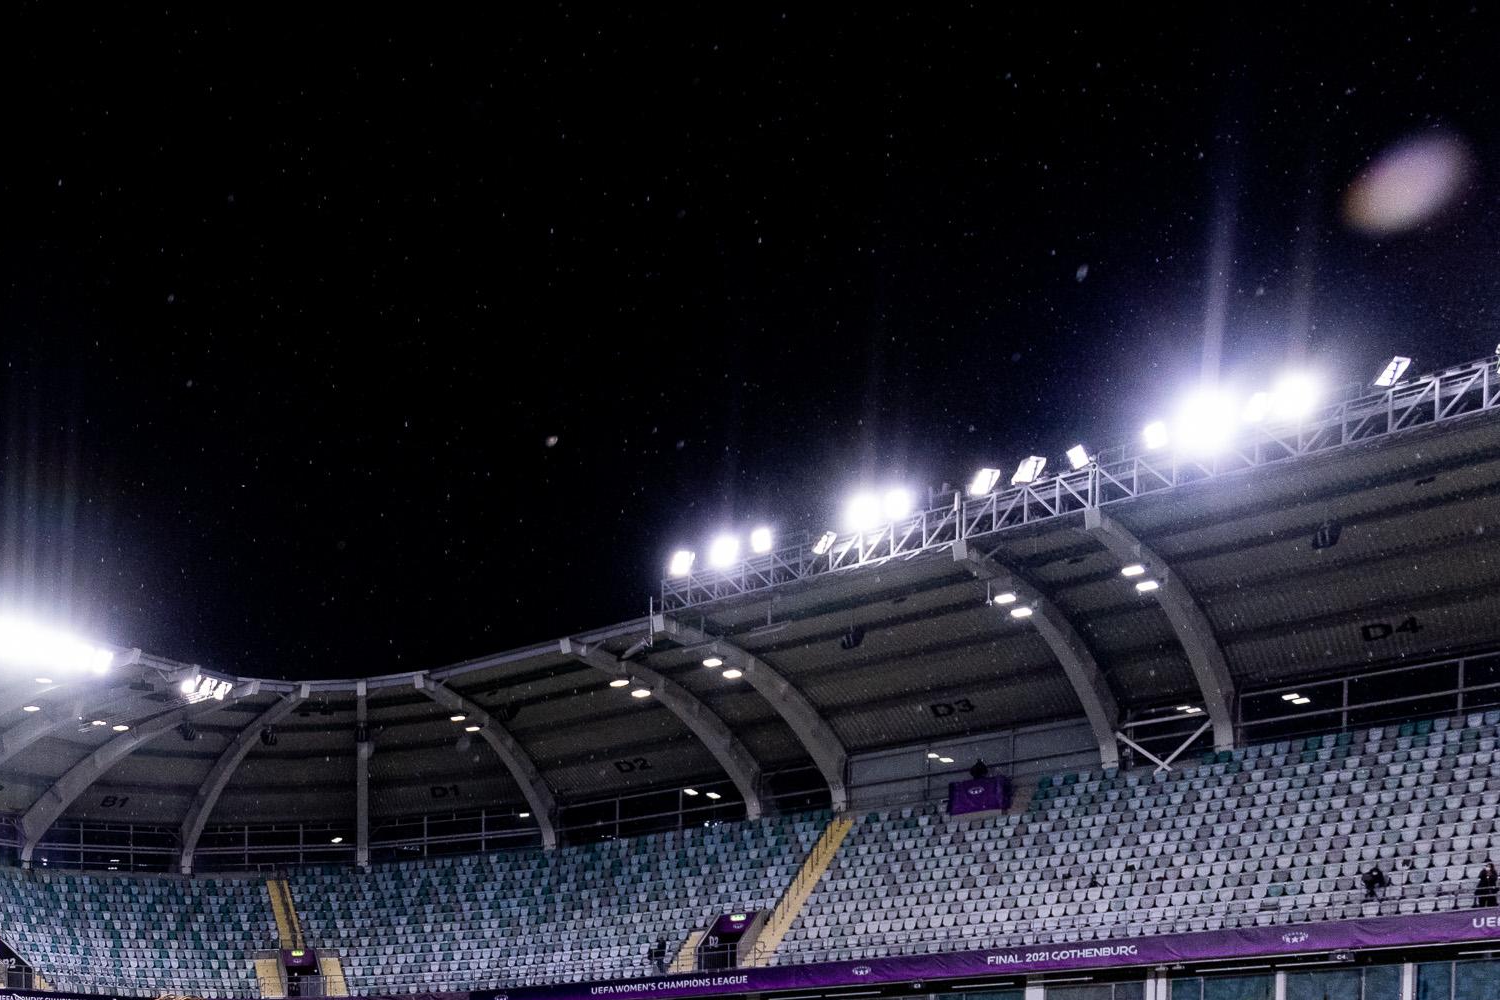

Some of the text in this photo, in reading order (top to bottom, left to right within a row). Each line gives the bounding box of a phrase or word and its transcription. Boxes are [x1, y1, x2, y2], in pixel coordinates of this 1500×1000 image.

[1361, 616, 1424, 642] D4
[930, 698, 976, 717] D3
[614, 758, 653, 773] D2
[430, 784, 460, 798] D1
[100, 796, 130, 808] B1
[987, 945, 1138, 965] FINAL 2021 GOTHENBURG
[591, 975, 748, 995] UEFA WOMEN'S CHAMPIONS LEAGUE
